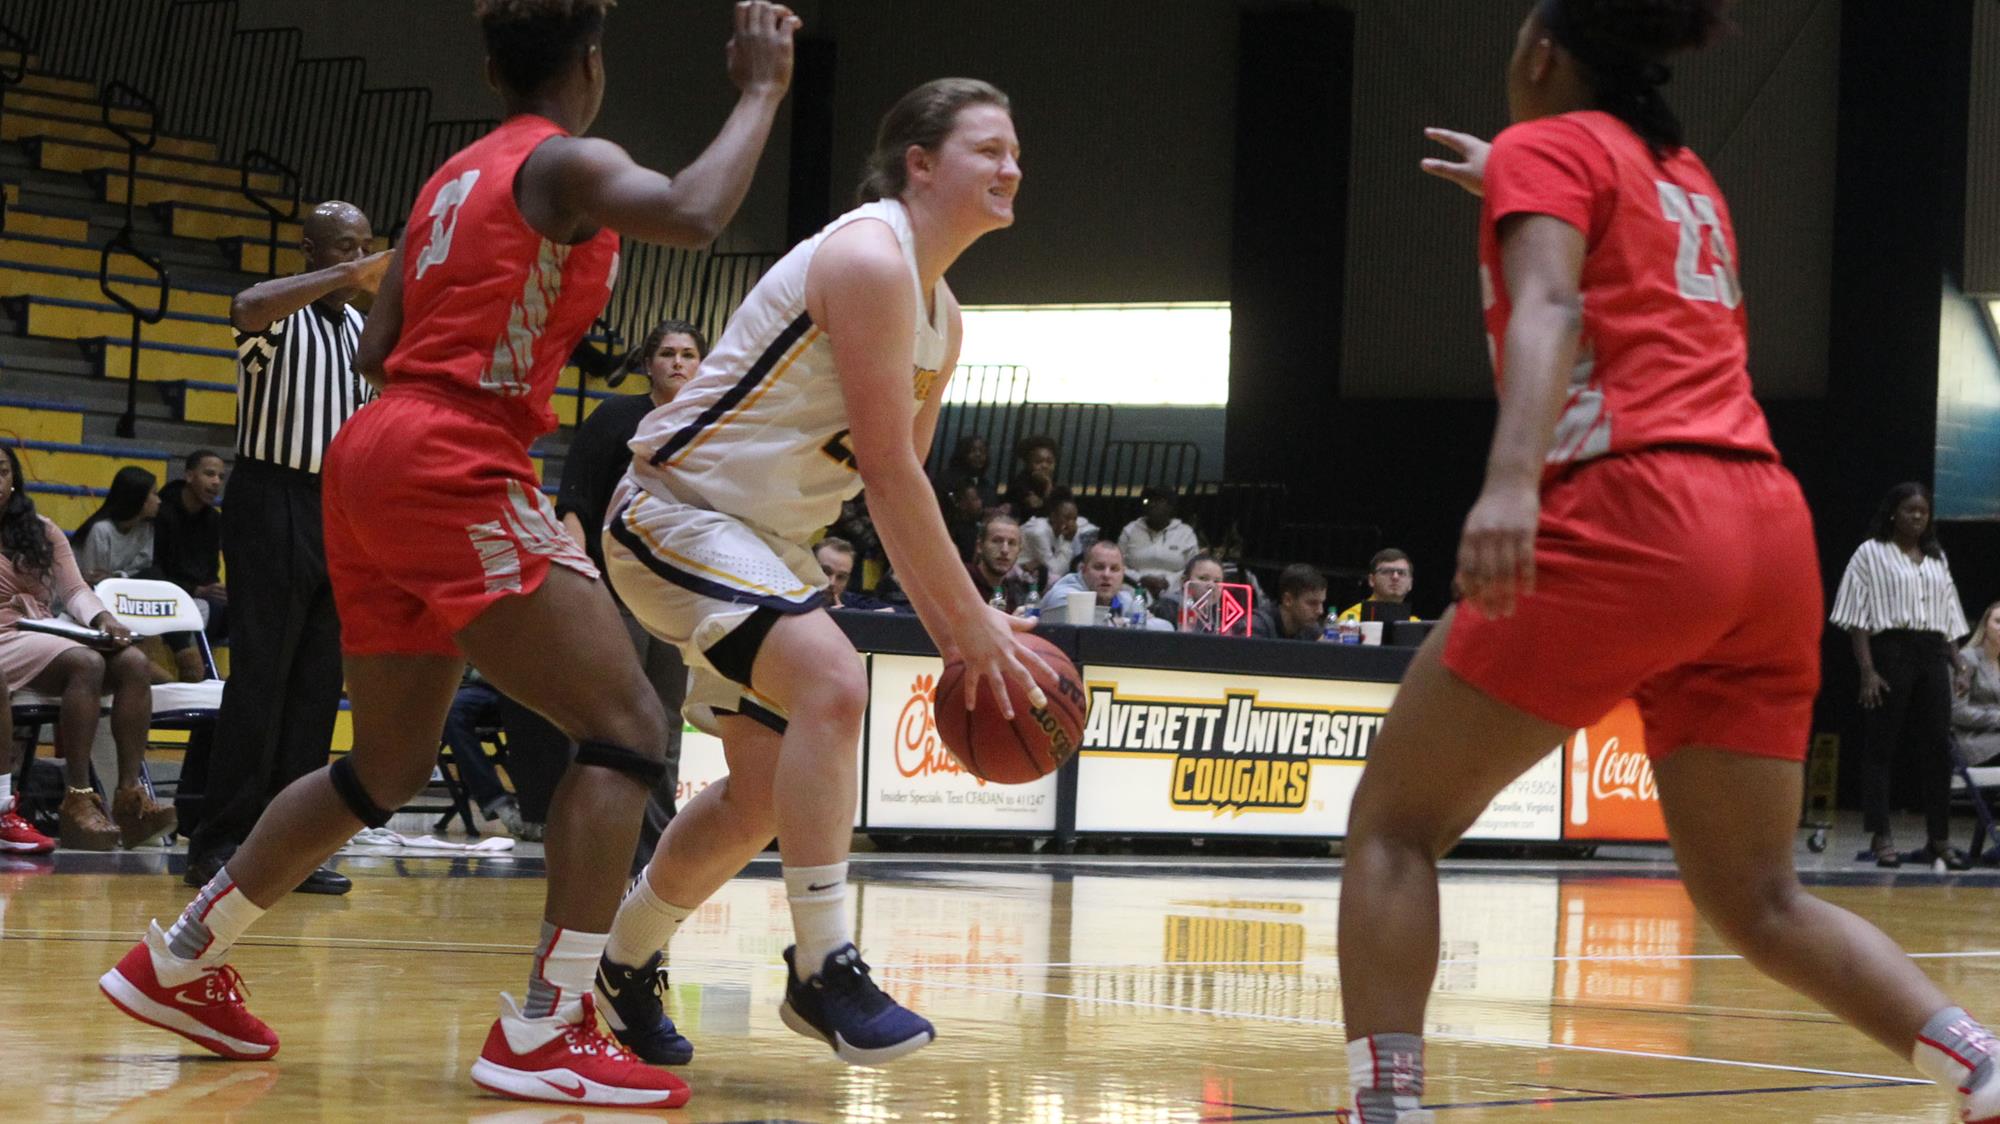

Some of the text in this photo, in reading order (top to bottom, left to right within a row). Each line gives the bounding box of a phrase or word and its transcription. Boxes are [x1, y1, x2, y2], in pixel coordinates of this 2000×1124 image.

[118, 596, 176, 616] AVERETT
[1083, 691, 1222, 751] AVERETT
[1174, 757, 1308, 804] COUGARS
[946, 790, 964, 804] Text
[1526, 801, 1556, 815] Virginia
